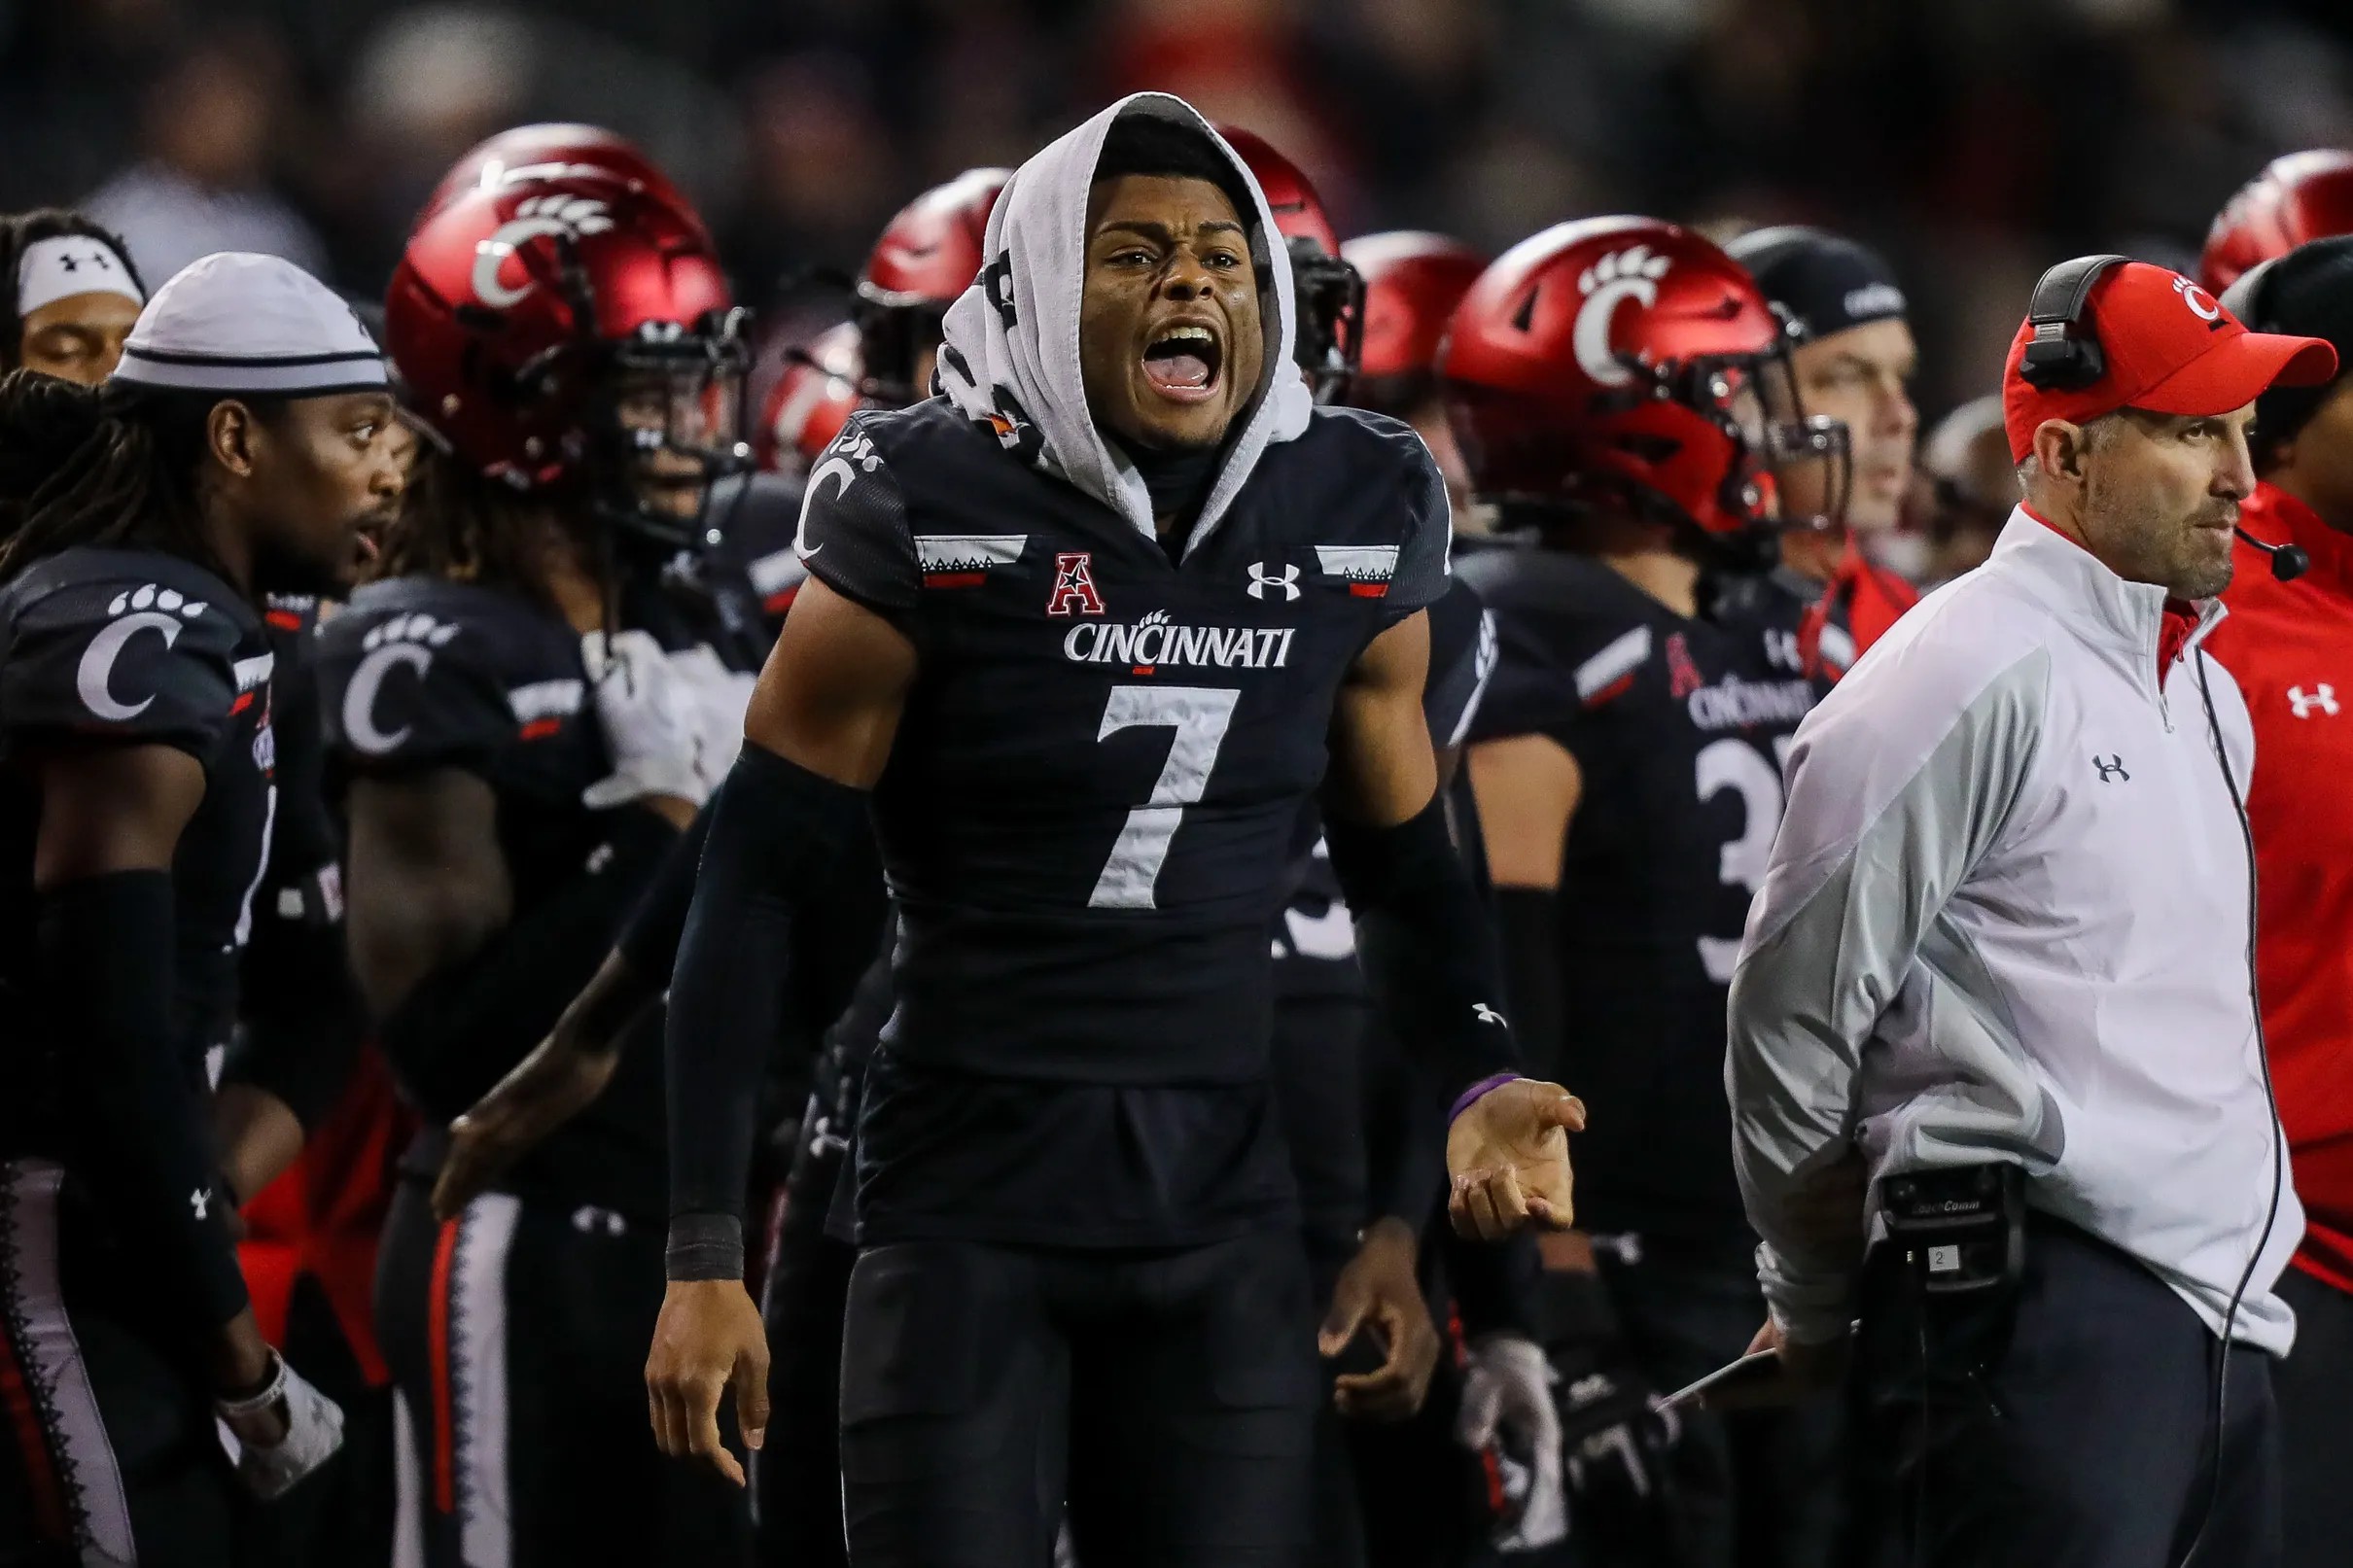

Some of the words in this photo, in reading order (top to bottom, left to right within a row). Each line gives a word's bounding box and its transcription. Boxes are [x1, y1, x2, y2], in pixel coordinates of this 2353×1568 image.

[1572, 278, 1658, 385] C
[2183, 285, 2220, 322] C
[1046, 552, 1106, 616] A
[78, 611, 183, 720] C
[1063, 610, 1295, 667] CINCINNATI
[343, 643, 434, 753] C
[1088, 685, 1240, 909] 7
[1935, 1250, 1944, 1265] 2
